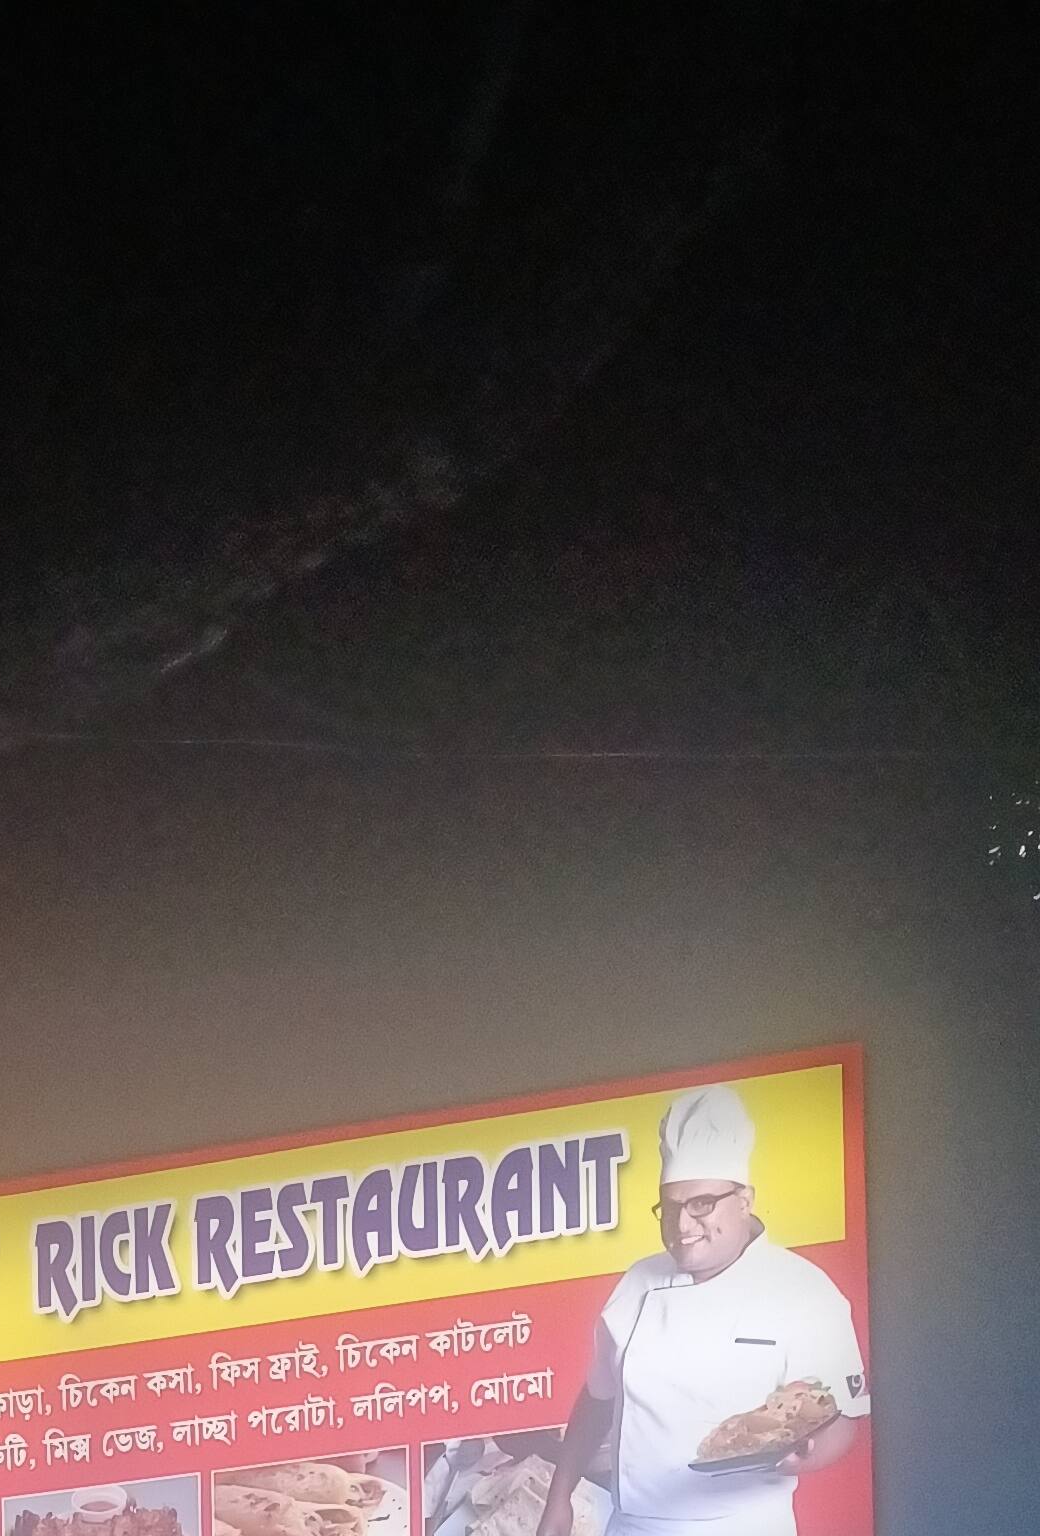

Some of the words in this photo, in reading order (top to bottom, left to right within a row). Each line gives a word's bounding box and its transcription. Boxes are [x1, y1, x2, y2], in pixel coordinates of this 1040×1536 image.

[34, 1203, 176, 1319] RICK
[193, 1133, 625, 1299] RESTAURANT
[57, 1373, 137, 1412] চিকেন
[143, 1362, 203, 1397] কসা,
[209, 1352, 262, 1391] ফিস
[267, 1341, 330, 1383] ফ্রাই,
[336, 1333, 420, 1373] চিকেন
[426, 1310, 533, 1357] কাটলেট
[102, 1423, 164, 1458] ভেজ,
[247, 1396, 345, 1438] পরোটা,
[350, 1380, 460, 1422] ললিপপ,
[470, 1366, 556, 1409] মোমো
